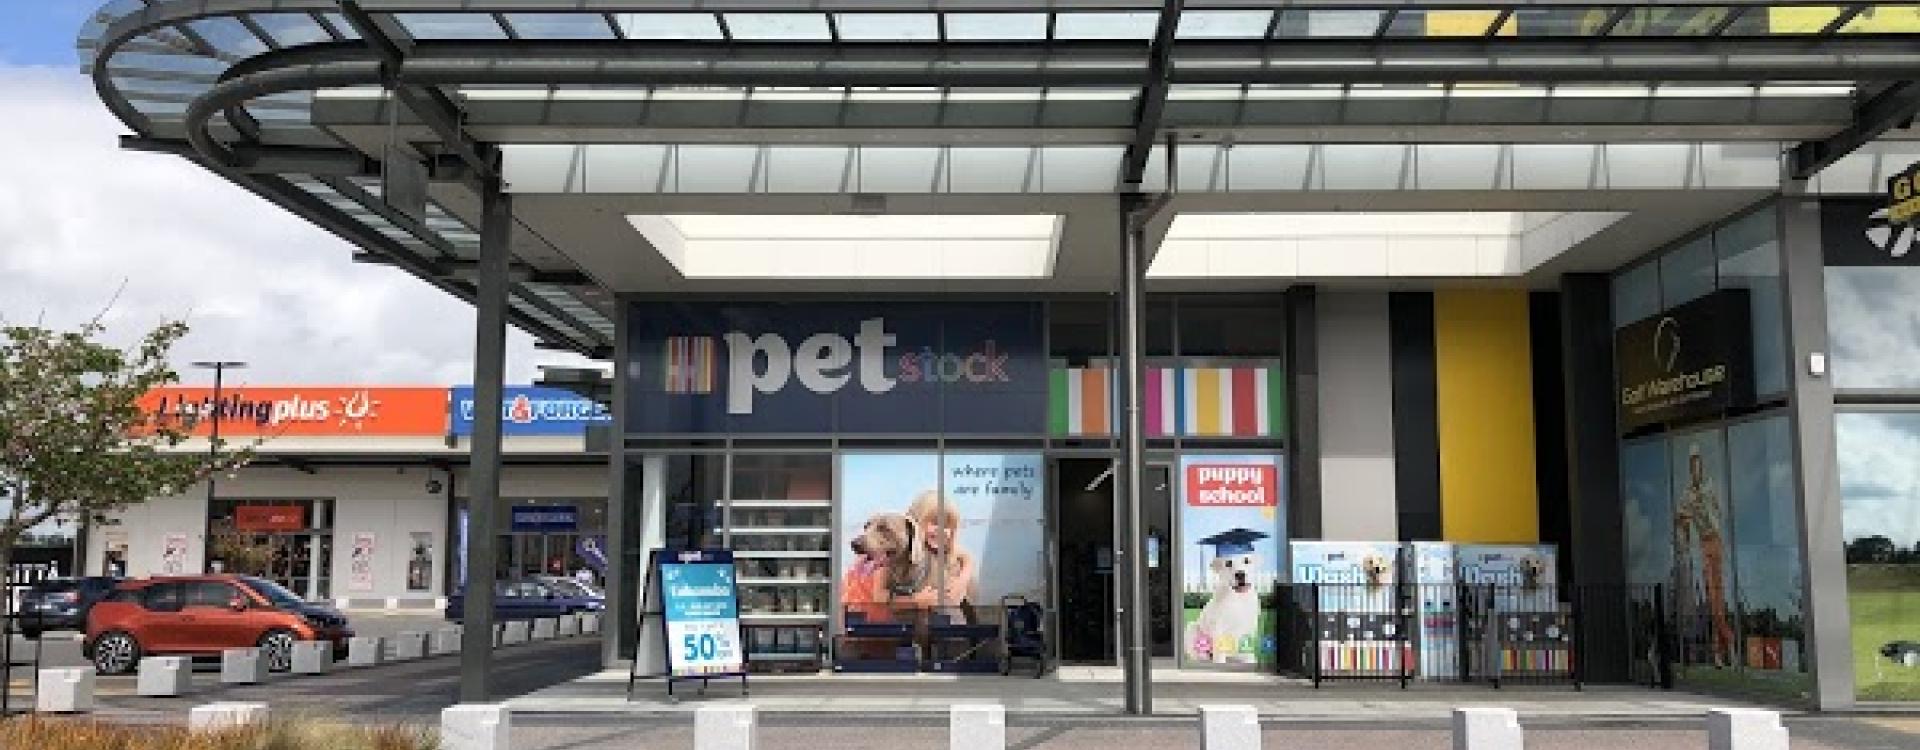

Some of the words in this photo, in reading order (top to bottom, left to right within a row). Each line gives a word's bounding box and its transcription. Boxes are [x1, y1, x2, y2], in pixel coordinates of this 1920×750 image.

[951, 464, 999, 478] where
[1004, 464, 1034, 481] pets
[1199, 467, 1263, 485] puppy
[985, 480, 1034, 500] family
[1199, 486, 1265, 504] school
[684, 633, 715, 661] 50
